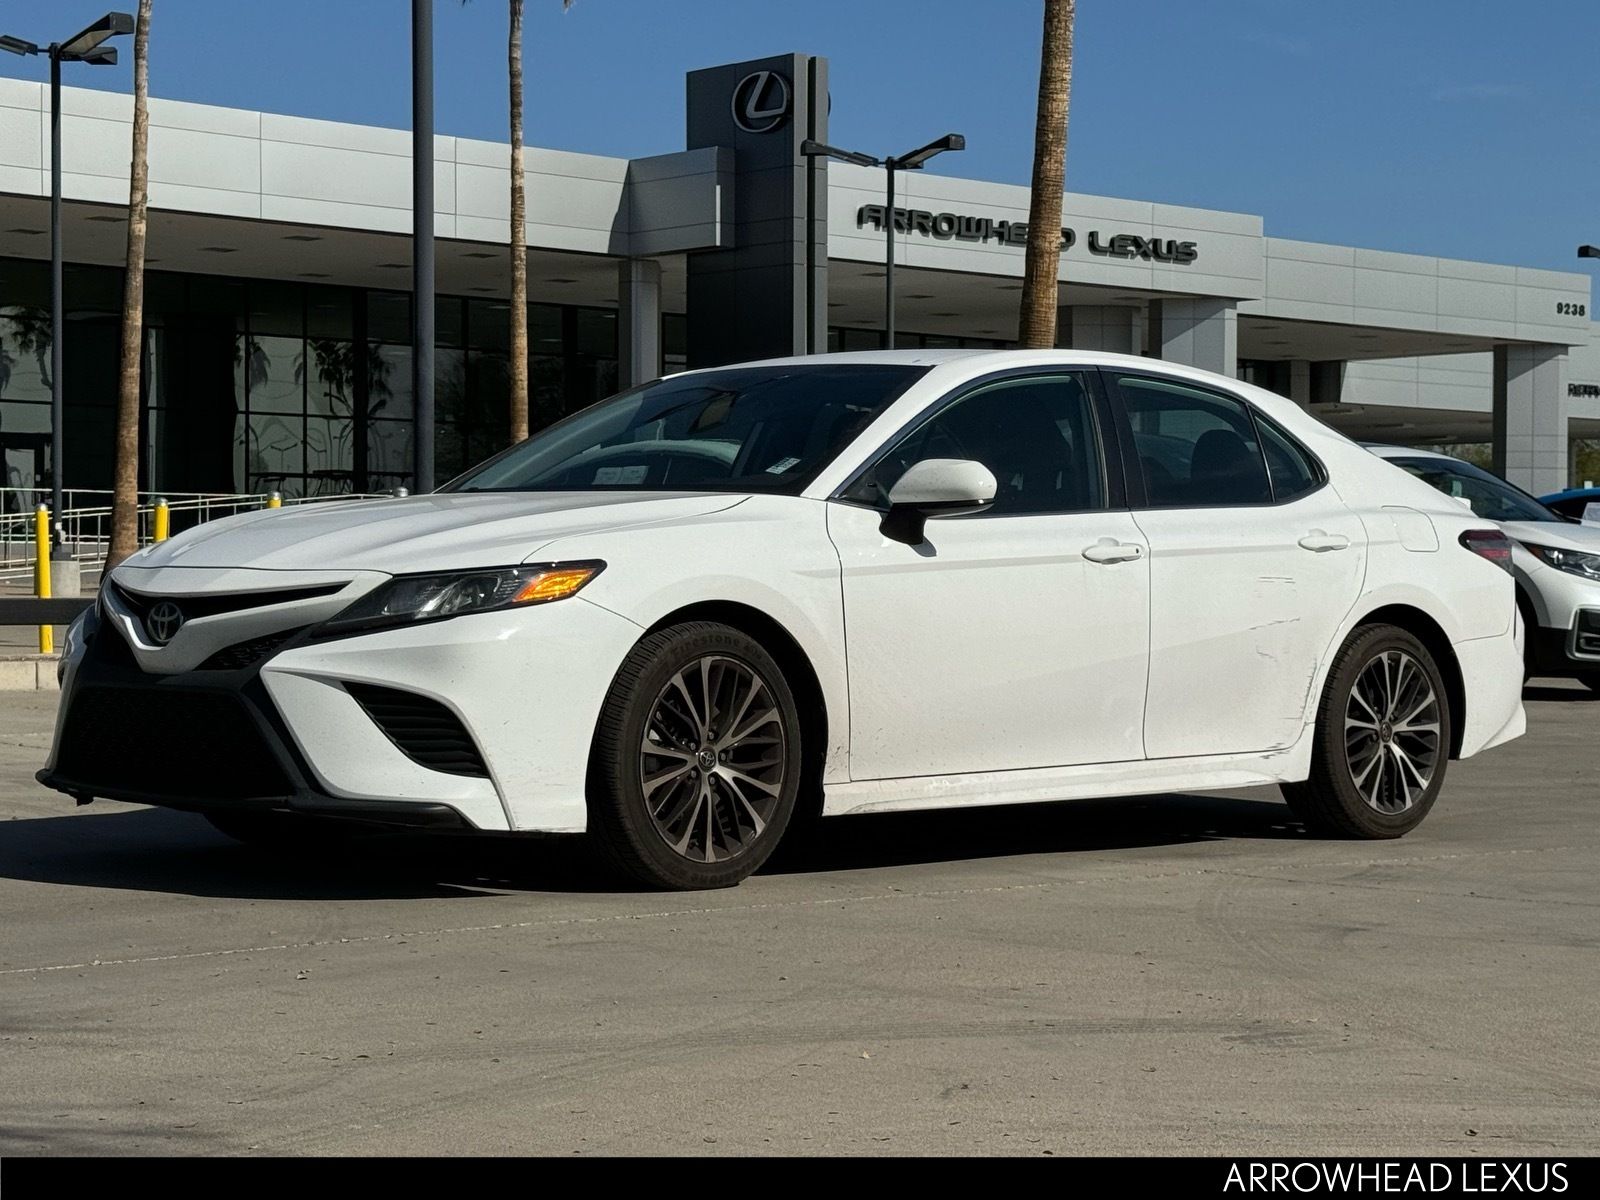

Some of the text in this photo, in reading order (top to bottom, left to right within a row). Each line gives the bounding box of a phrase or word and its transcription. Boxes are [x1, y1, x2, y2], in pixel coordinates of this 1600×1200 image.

[857, 203, 1198, 266] ARROWHED LEXUS
[1556, 302, 1586, 317] 9238
